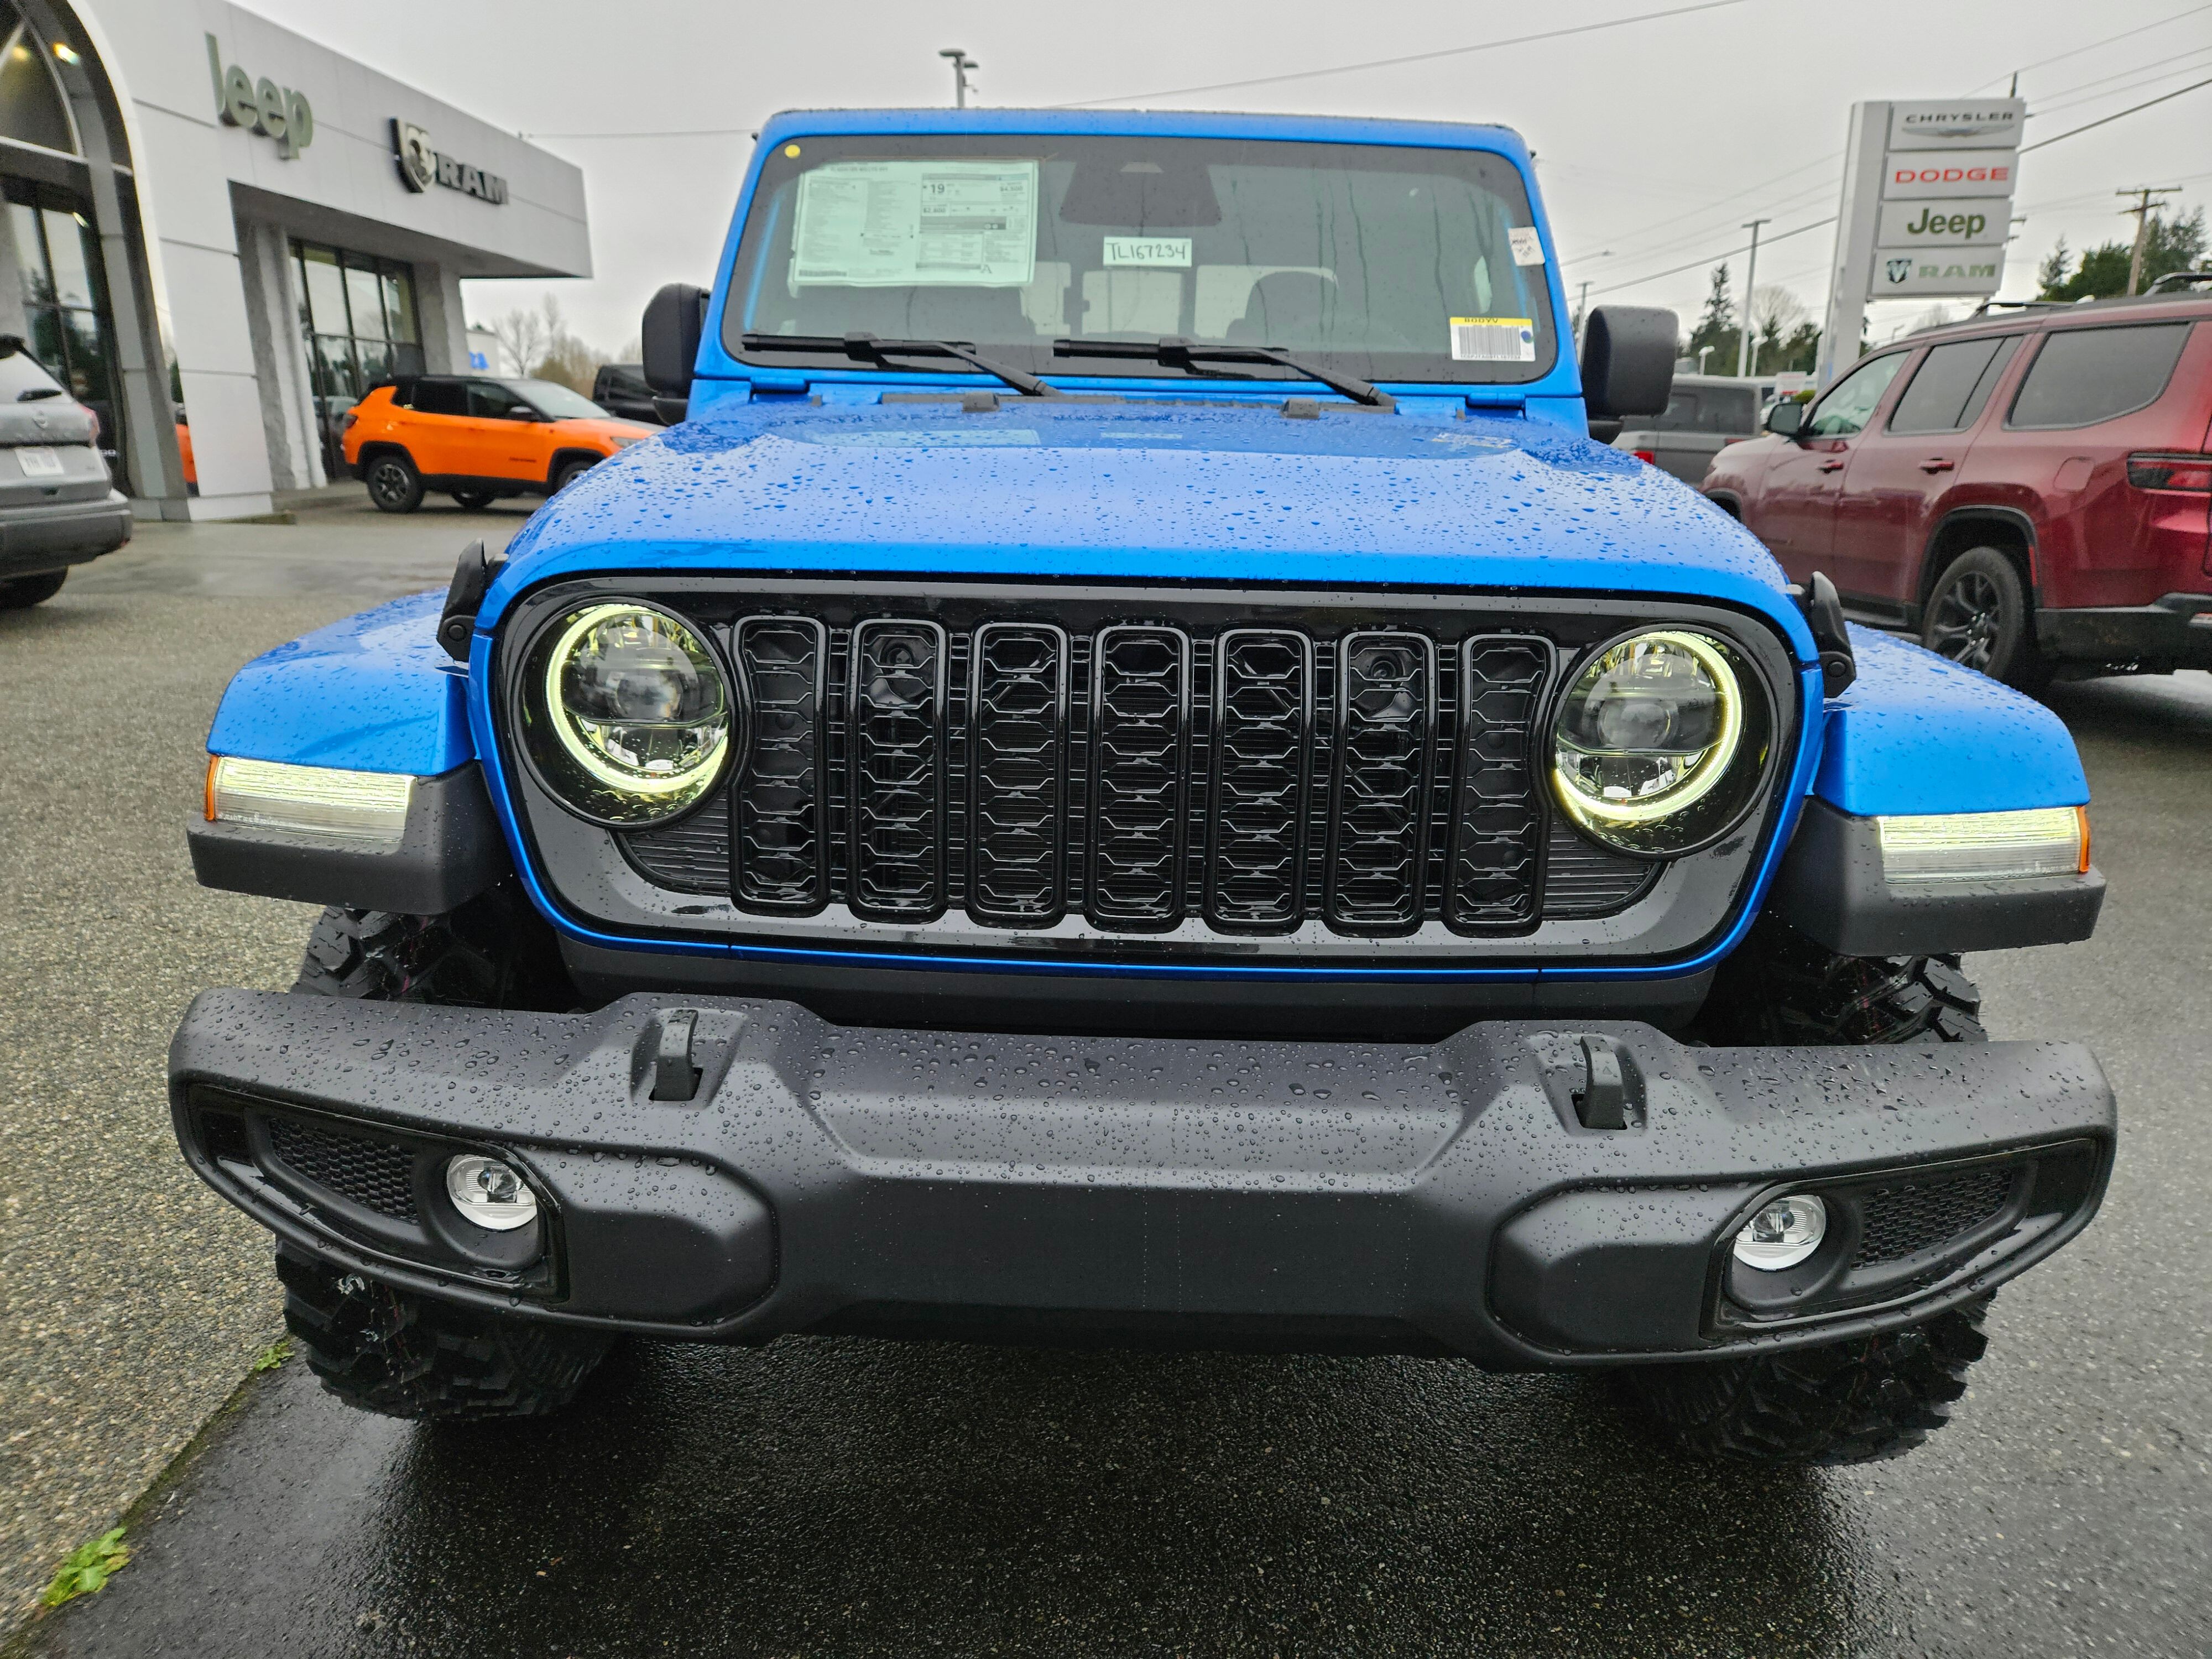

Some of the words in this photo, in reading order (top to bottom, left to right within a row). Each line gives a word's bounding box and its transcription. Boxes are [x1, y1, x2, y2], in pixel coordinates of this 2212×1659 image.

[204, 32, 314, 160] Jeep
[1905, 112, 2013, 124] CHRYSLER
[434, 151, 508, 205] RAM
[1895, 167, 2010, 184] DODGE
[1907, 208, 1986, 239] Jeep
[1106, 242, 1186, 260] TL167234
[1918, 264, 1996, 278] RAM
